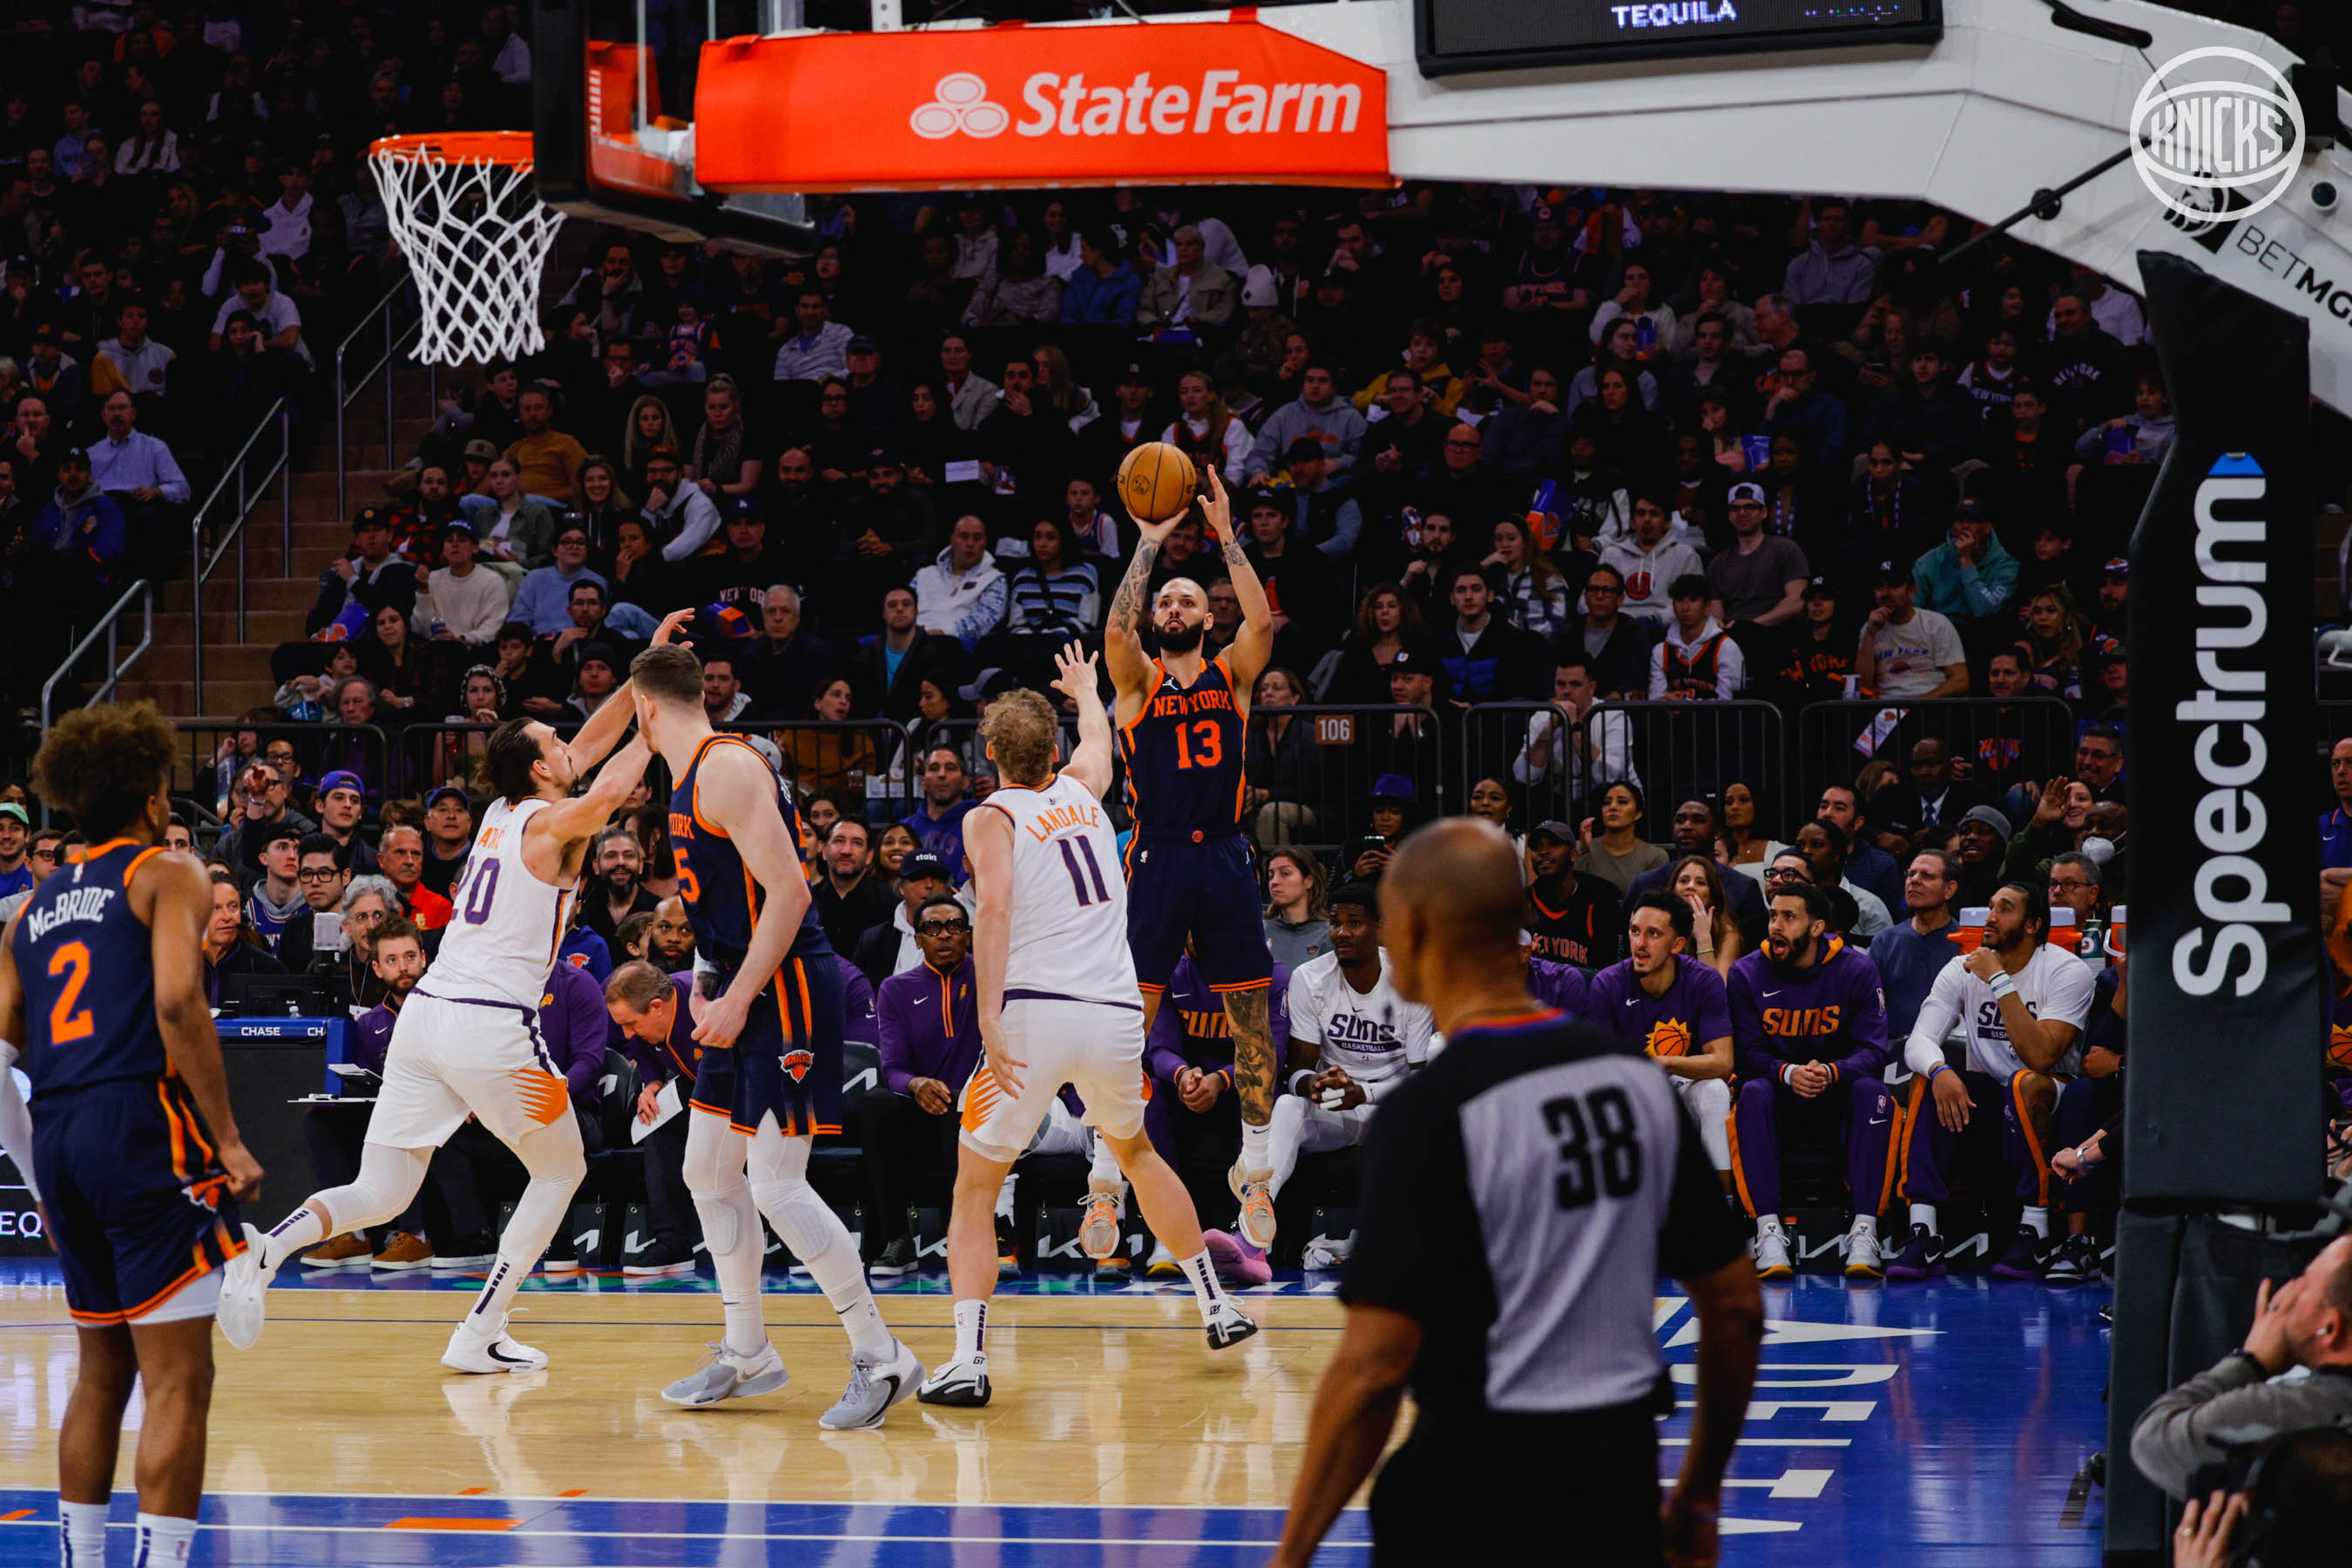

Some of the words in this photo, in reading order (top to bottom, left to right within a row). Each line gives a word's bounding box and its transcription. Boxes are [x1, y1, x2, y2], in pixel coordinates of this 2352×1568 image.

[1612, 0, 1737, 28] TEQUILA
[2236, 224, 2352, 328] BETMG
[1153, 694, 1189, 719] NEW
[1188, 689, 1232, 713] YORK
[1175, 720, 1222, 769] 13
[1319, 719, 1350, 740] 106
[2173, 479, 2292, 997] Spectrum
[1025, 804, 1100, 843] LANDALE
[1056, 834, 1113, 907] 11
[28, 887, 115, 943] McBRIDE
[49, 940, 94, 1045] 2
[240, 1026, 281, 1037] CHASE
[1342, 1042, 1386, 1052] BASKETBALL
[1540, 1084, 1642, 1208] 38
